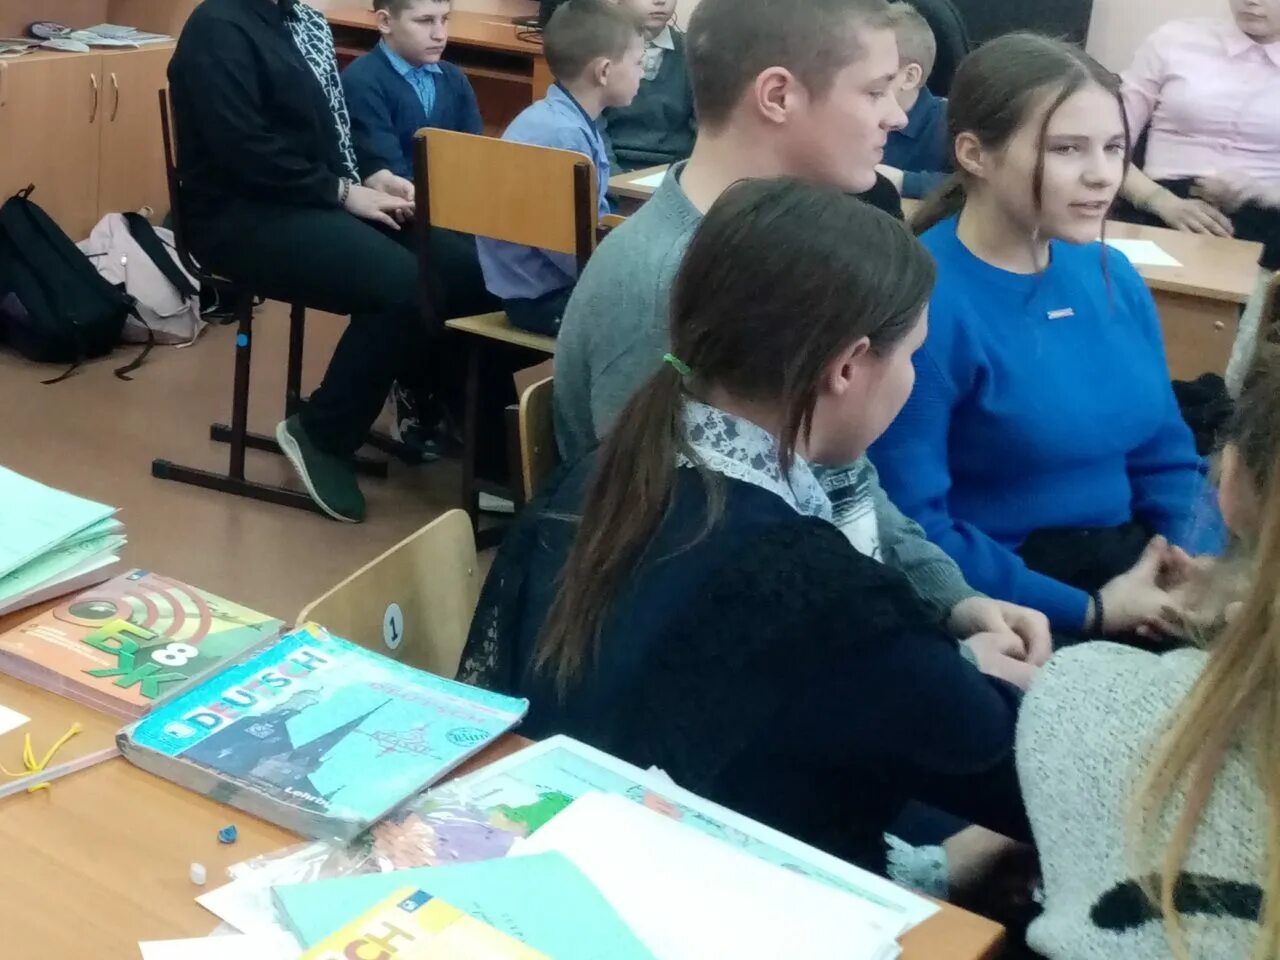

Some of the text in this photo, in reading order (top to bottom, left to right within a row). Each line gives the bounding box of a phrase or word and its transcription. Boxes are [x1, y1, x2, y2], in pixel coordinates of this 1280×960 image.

[389, 616, 398, 643] 1
[151, 642, 199, 667] 8
[186, 649, 329, 731] DEUTSCH
